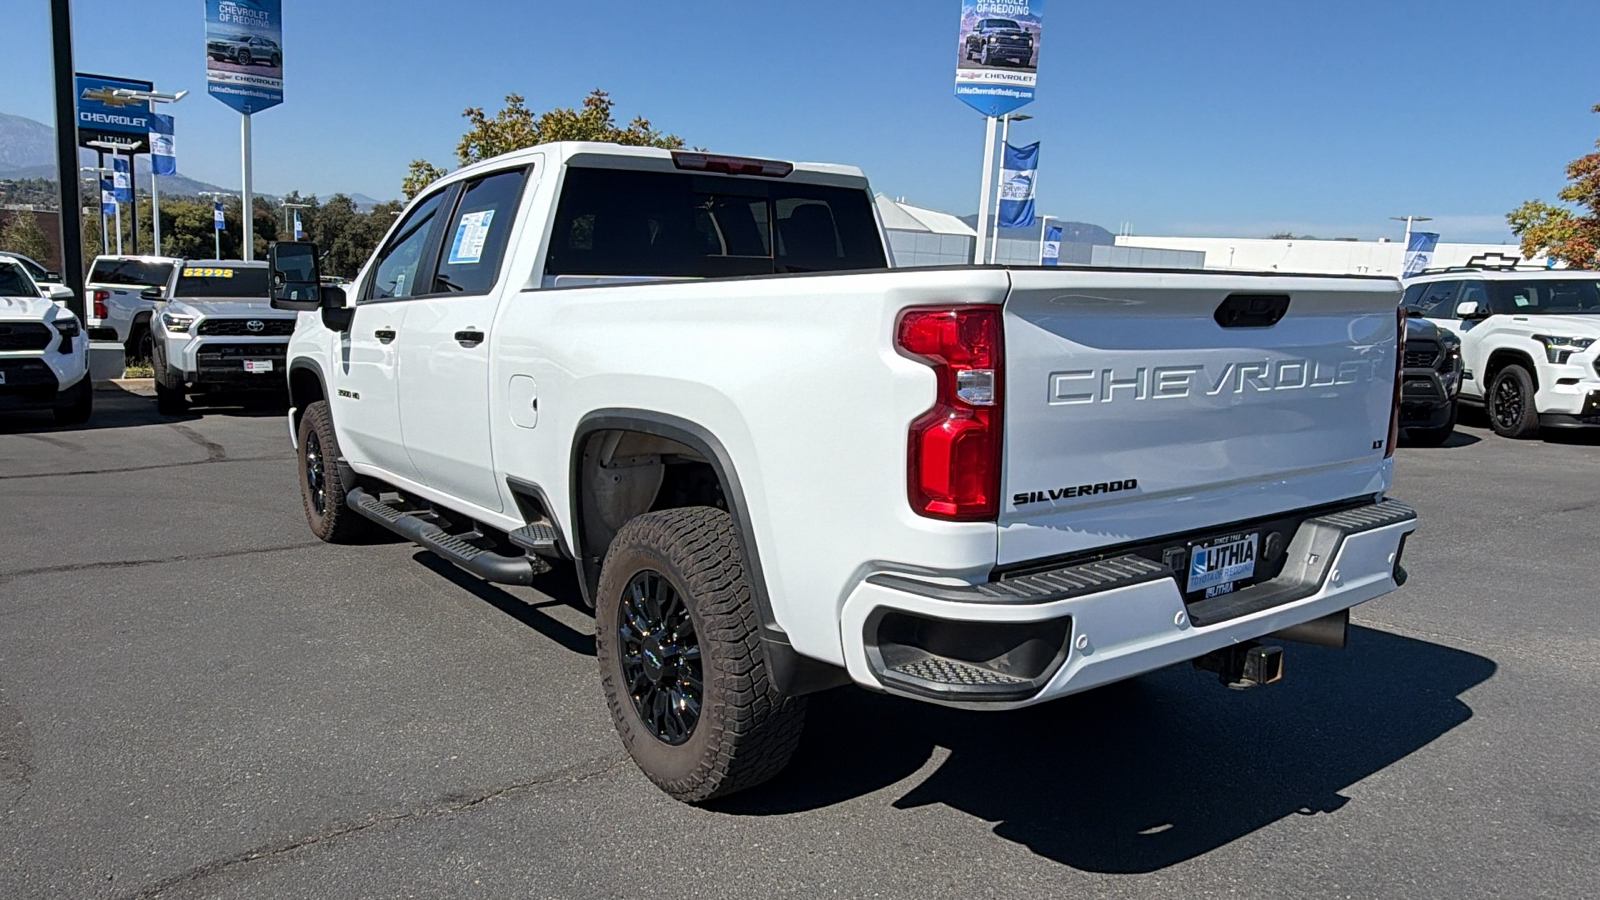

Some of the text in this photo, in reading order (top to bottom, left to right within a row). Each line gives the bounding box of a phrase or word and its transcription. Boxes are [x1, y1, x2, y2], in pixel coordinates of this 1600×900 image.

[219, 5, 269, 20] CHEVROLET
[976, 3, 1030, 15] OF REDDING
[219, 13, 270, 28] OF REDDING
[235, 75, 280, 87] CHEVROLET
[985, 73, 1033, 82] CHEVROLET
[80, 112, 148, 127] CHEVROLET
[183, 267, 233, 278] 52995
[1048, 358, 1384, 405] CHEVROLET
[1372, 440, 1384, 449] LT
[1013, 479, 1137, 505] SILVERADO
[1206, 540, 1254, 573] LITHIA
[1191, 572, 1213, 586] TOYOTA
[1224, 562, 1253, 578] REDDING
